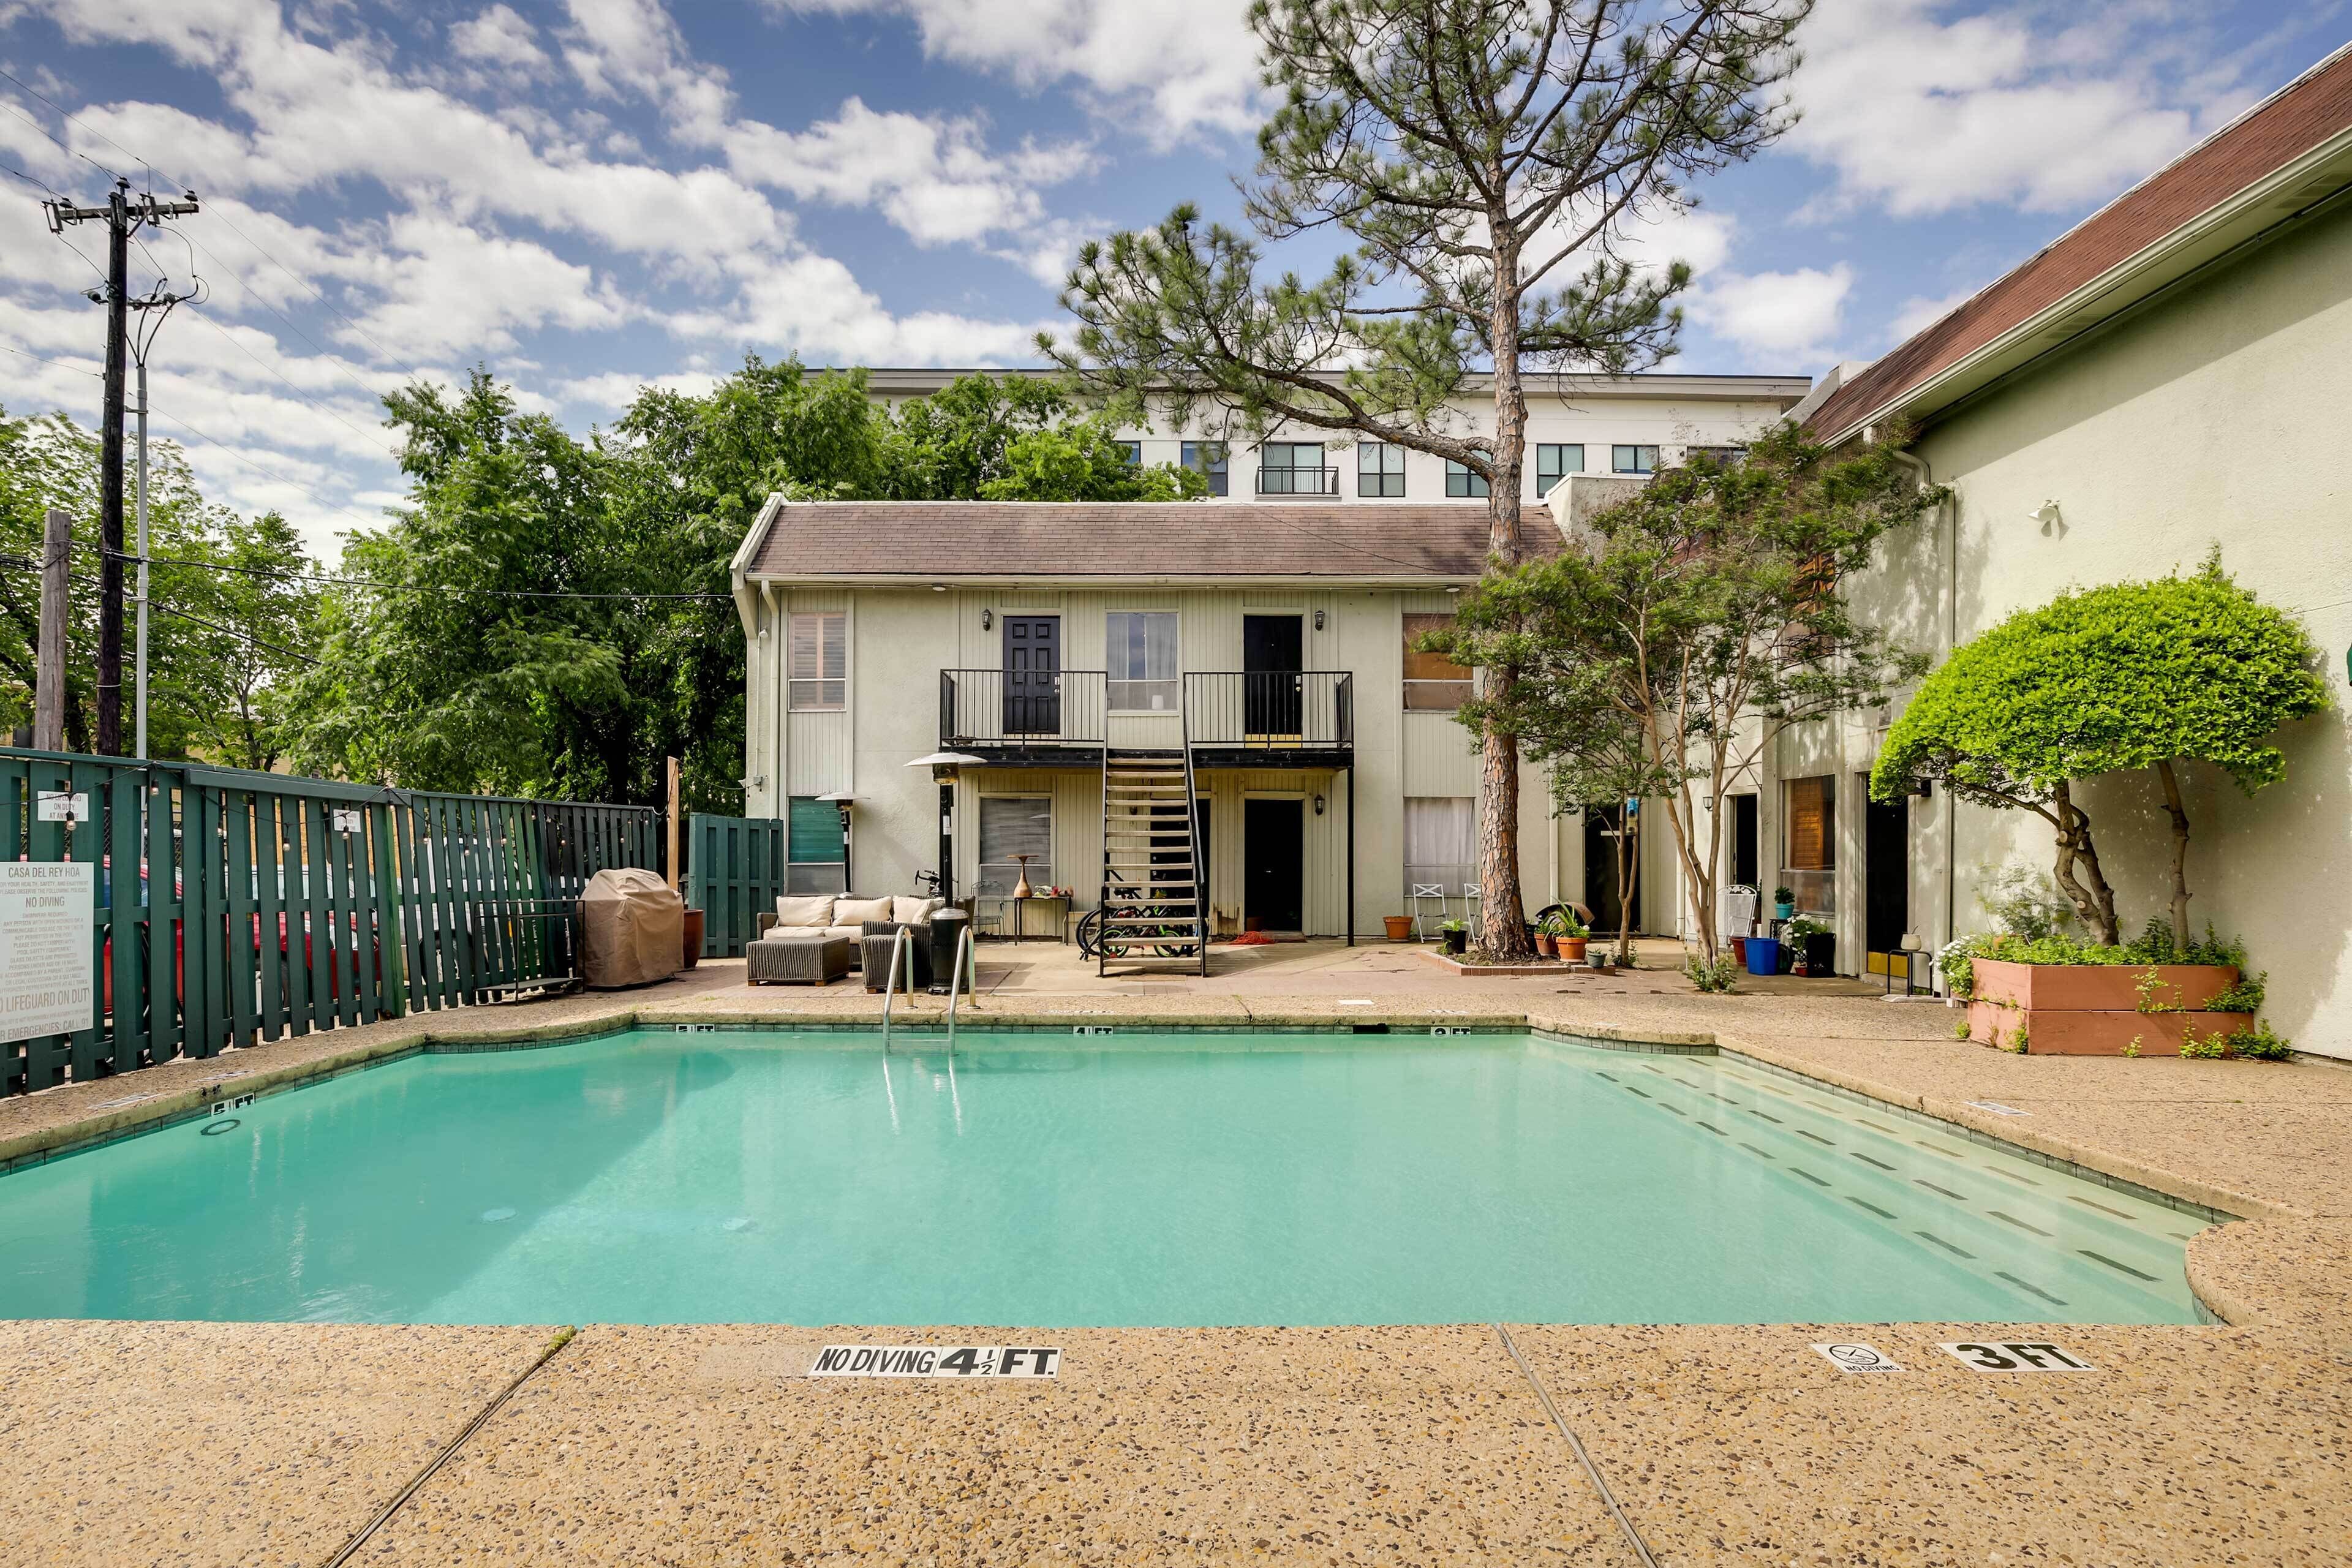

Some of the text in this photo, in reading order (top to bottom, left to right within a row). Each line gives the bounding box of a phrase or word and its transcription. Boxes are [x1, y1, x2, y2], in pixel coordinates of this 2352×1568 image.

[9, 867, 80, 878] CASA DEL REY HOA
[26, 896, 65, 907] NO DIVING
[6, 992, 55, 1012] LIFEGUARD
[58, 990, 69, 1005] ON
[72, 987, 89, 1004] DUT
[64, 1019, 79, 1031] CALL
[815, 1348, 851, 1371] NO
[850, 1348, 935, 1373] DIVING
